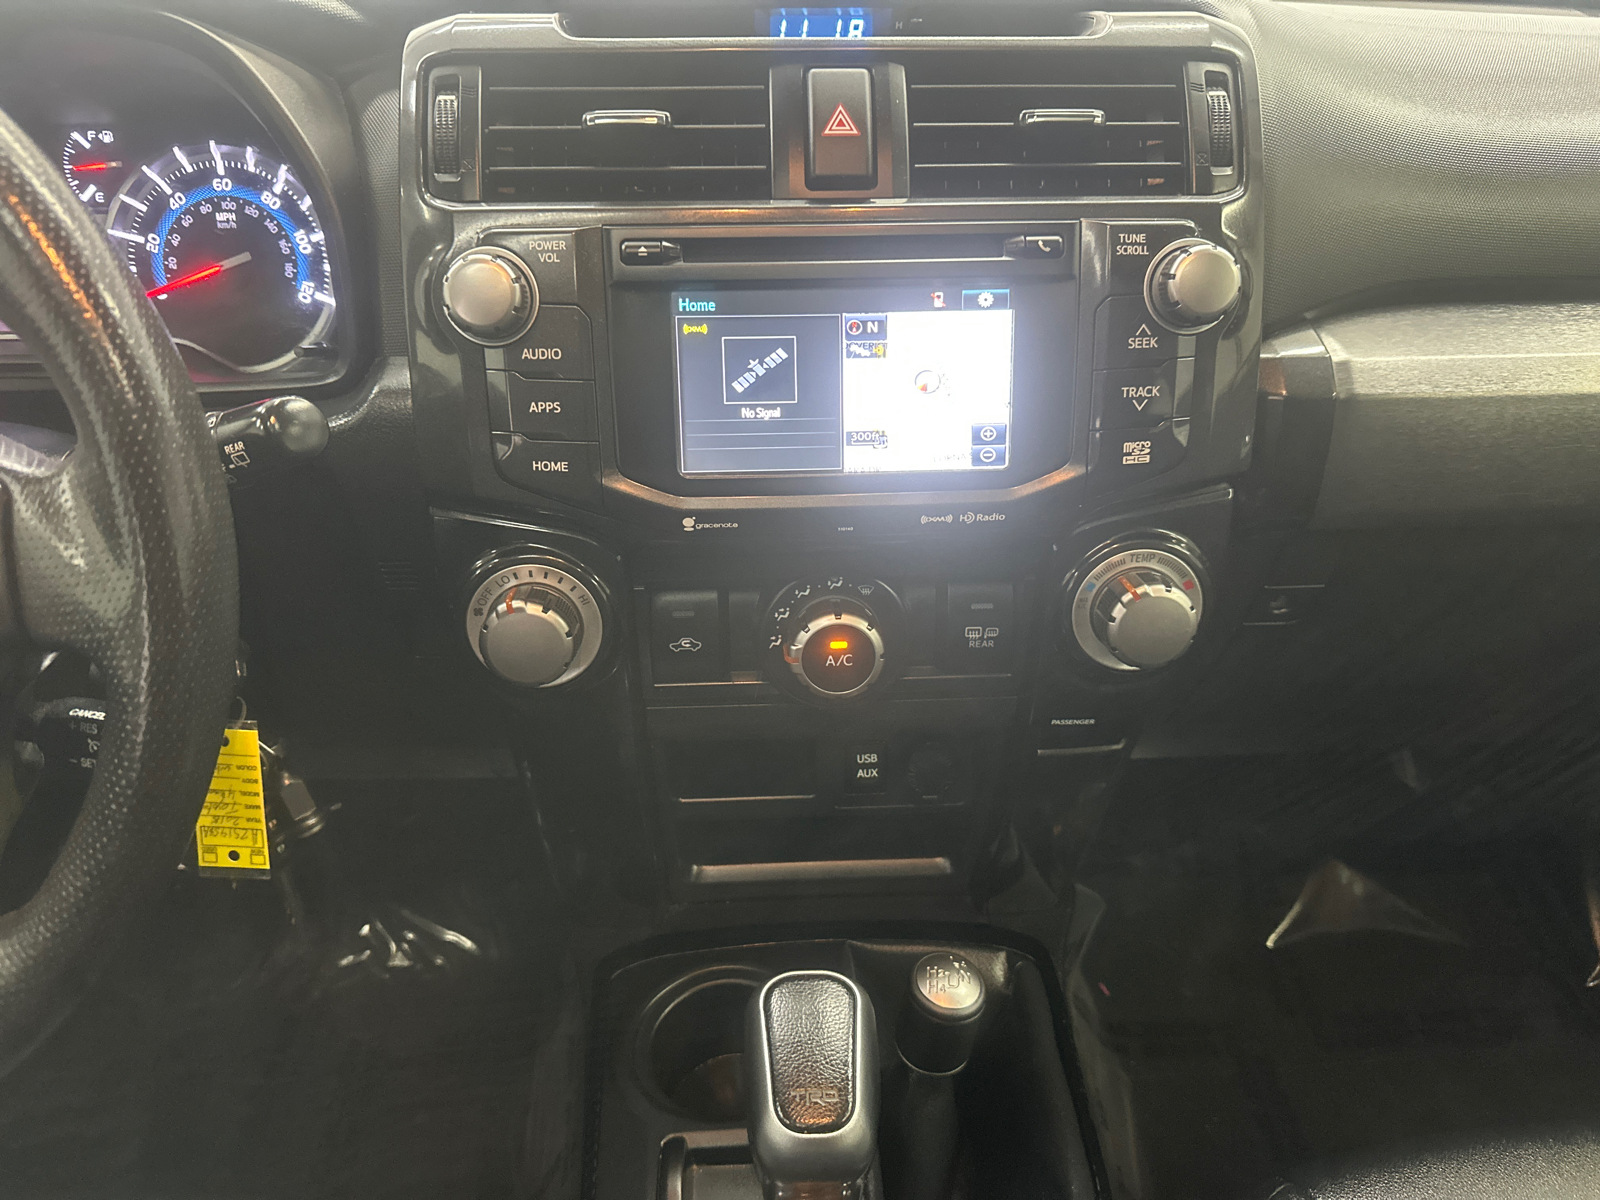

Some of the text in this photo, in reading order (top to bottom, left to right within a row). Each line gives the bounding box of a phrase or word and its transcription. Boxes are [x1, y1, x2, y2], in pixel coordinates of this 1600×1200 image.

[87, 131, 96, 140] F
[212, 178, 232, 191] 60
[95, 192, 104, 203] E
[169, 192, 186, 210] 40
[260, 190, 281, 210] 80
[199, 203, 212, 214] 80
[221, 201, 236, 210] 100
[244, 205, 259, 218] 120
[181, 214, 193, 228] 60
[215, 212, 236, 221] MPH
[216, 220, 237, 229] km/h
[263, 218, 279, 234] 140
[145, 233, 160, 254] 20
[170, 233, 181, 247] 40
[293, 228, 312, 254] 100
[1118, 233, 1146, 244] TUNE
[278, 238, 291, 255] 160
[528, 240, 566, 251] POWER
[1116, 245, 1149, 256] SCROLL
[168, 256, 178, 270] 20
[538, 253, 560, 263] VOL
[297, 281, 315, 304] 120
[678, 298, 716, 313] Home
[867, 321, 879, 333] N
[1128, 337, 1158, 349] SEEK
[521, 348, 562, 360] AUDIO
[1121, 386, 1160, 398] TRACK
[529, 401, 561, 413] APPS
[741, 406, 781, 420] No Signal
[224, 441, 245, 455] REAR
[532, 461, 569, 472] HOME
[976, 512, 1006, 522] Radio
[695, 522, 738, 530] gracenote
[1129, 553, 1156, 564] TEMP
[495, 575, 511, 588] LO
[477, 586, 494, 607] OFF
[578, 594, 590, 606] HI
[968, 640, 995, 648] REAR
[825, 653, 853, 667] A/C
[69, 708, 107, 721] CANCEL
[79, 722, 98, 735] RES
[856, 754, 878, 763] USB
[856, 768, 878, 778] AUX
[791, 1088, 839, 1105] TRD
